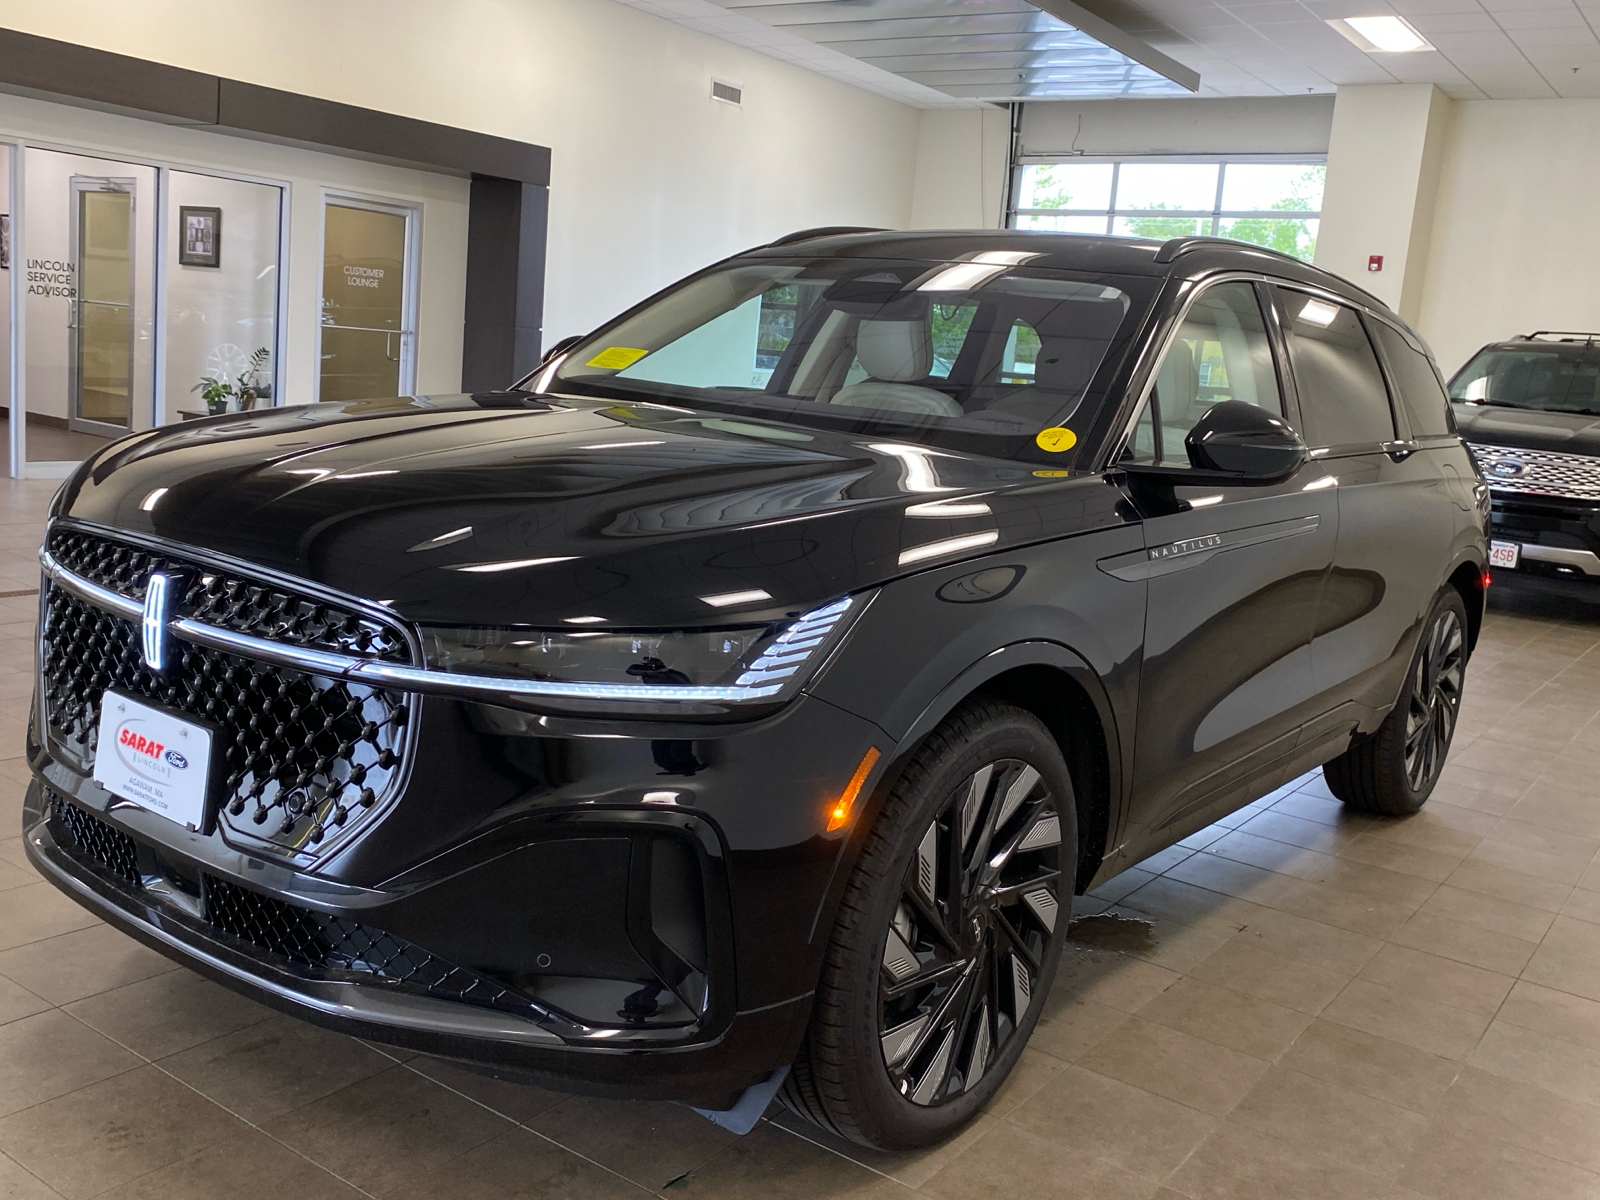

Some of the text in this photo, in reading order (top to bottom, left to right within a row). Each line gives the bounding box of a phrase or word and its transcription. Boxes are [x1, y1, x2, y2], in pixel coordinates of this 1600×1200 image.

[27, 258, 75, 273] LINCOLN
[343, 265, 384, 278] CUSTOMER
[27, 271, 71, 285] SERVICE
[347, 276, 379, 288] LOUNGE
[27, 285, 77, 299] ADVISOR
[1151, 536, 1222, 559] NAUTILUS
[119, 728, 164, 760] SARAT
[137, 756, 166, 774] LINCOLN
[166, 751, 186, 769] Ford
[154, 788, 164, 799] MA
